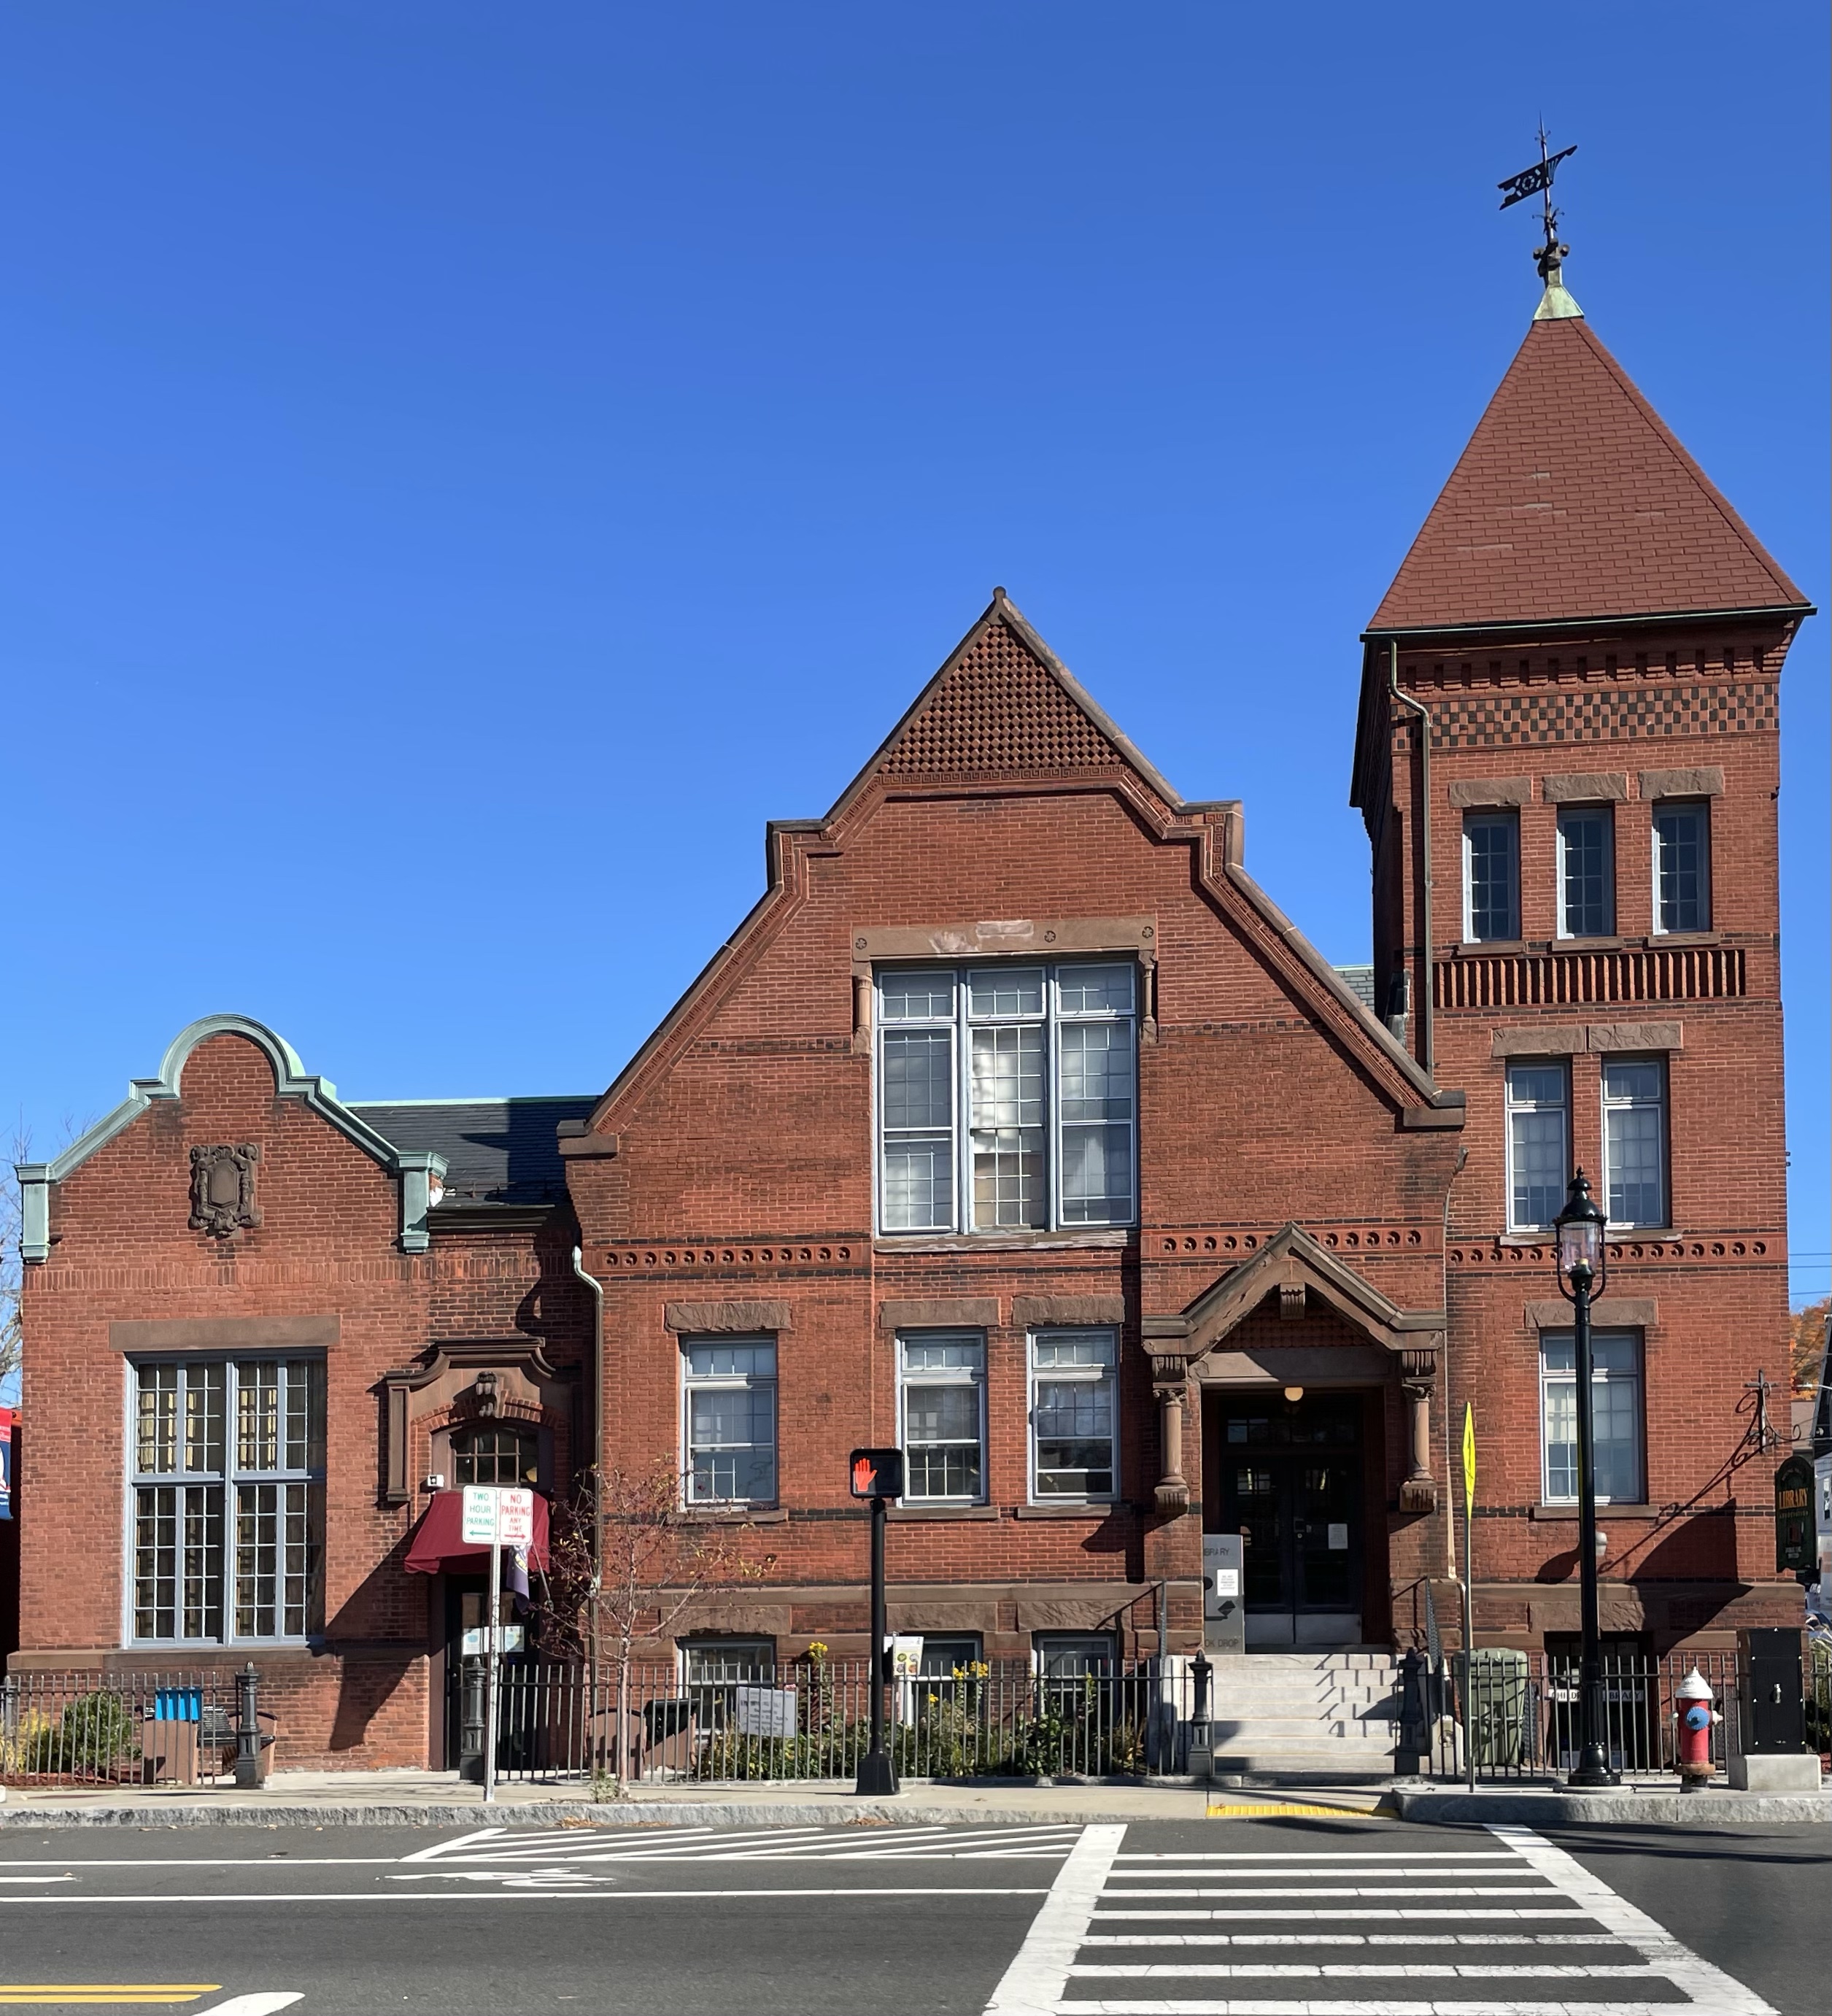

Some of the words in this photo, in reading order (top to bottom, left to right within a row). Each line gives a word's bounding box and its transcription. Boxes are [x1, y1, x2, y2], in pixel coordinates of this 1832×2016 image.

[473, 1492, 489, 1501] TWO
[510, 1494, 522, 1504] NO
[1779, 1488, 1808, 1509] LIBRARY
[469, 1505, 491, 1513] HOUR
[501, 1505, 530, 1516] PARKING
[466, 1518, 495, 1526] PARKING
[1203, 1547, 1230, 1556] BRARY
[1204, 1639, 1215, 1648] OK
[1218, 1638, 1239, 1648] DROP
